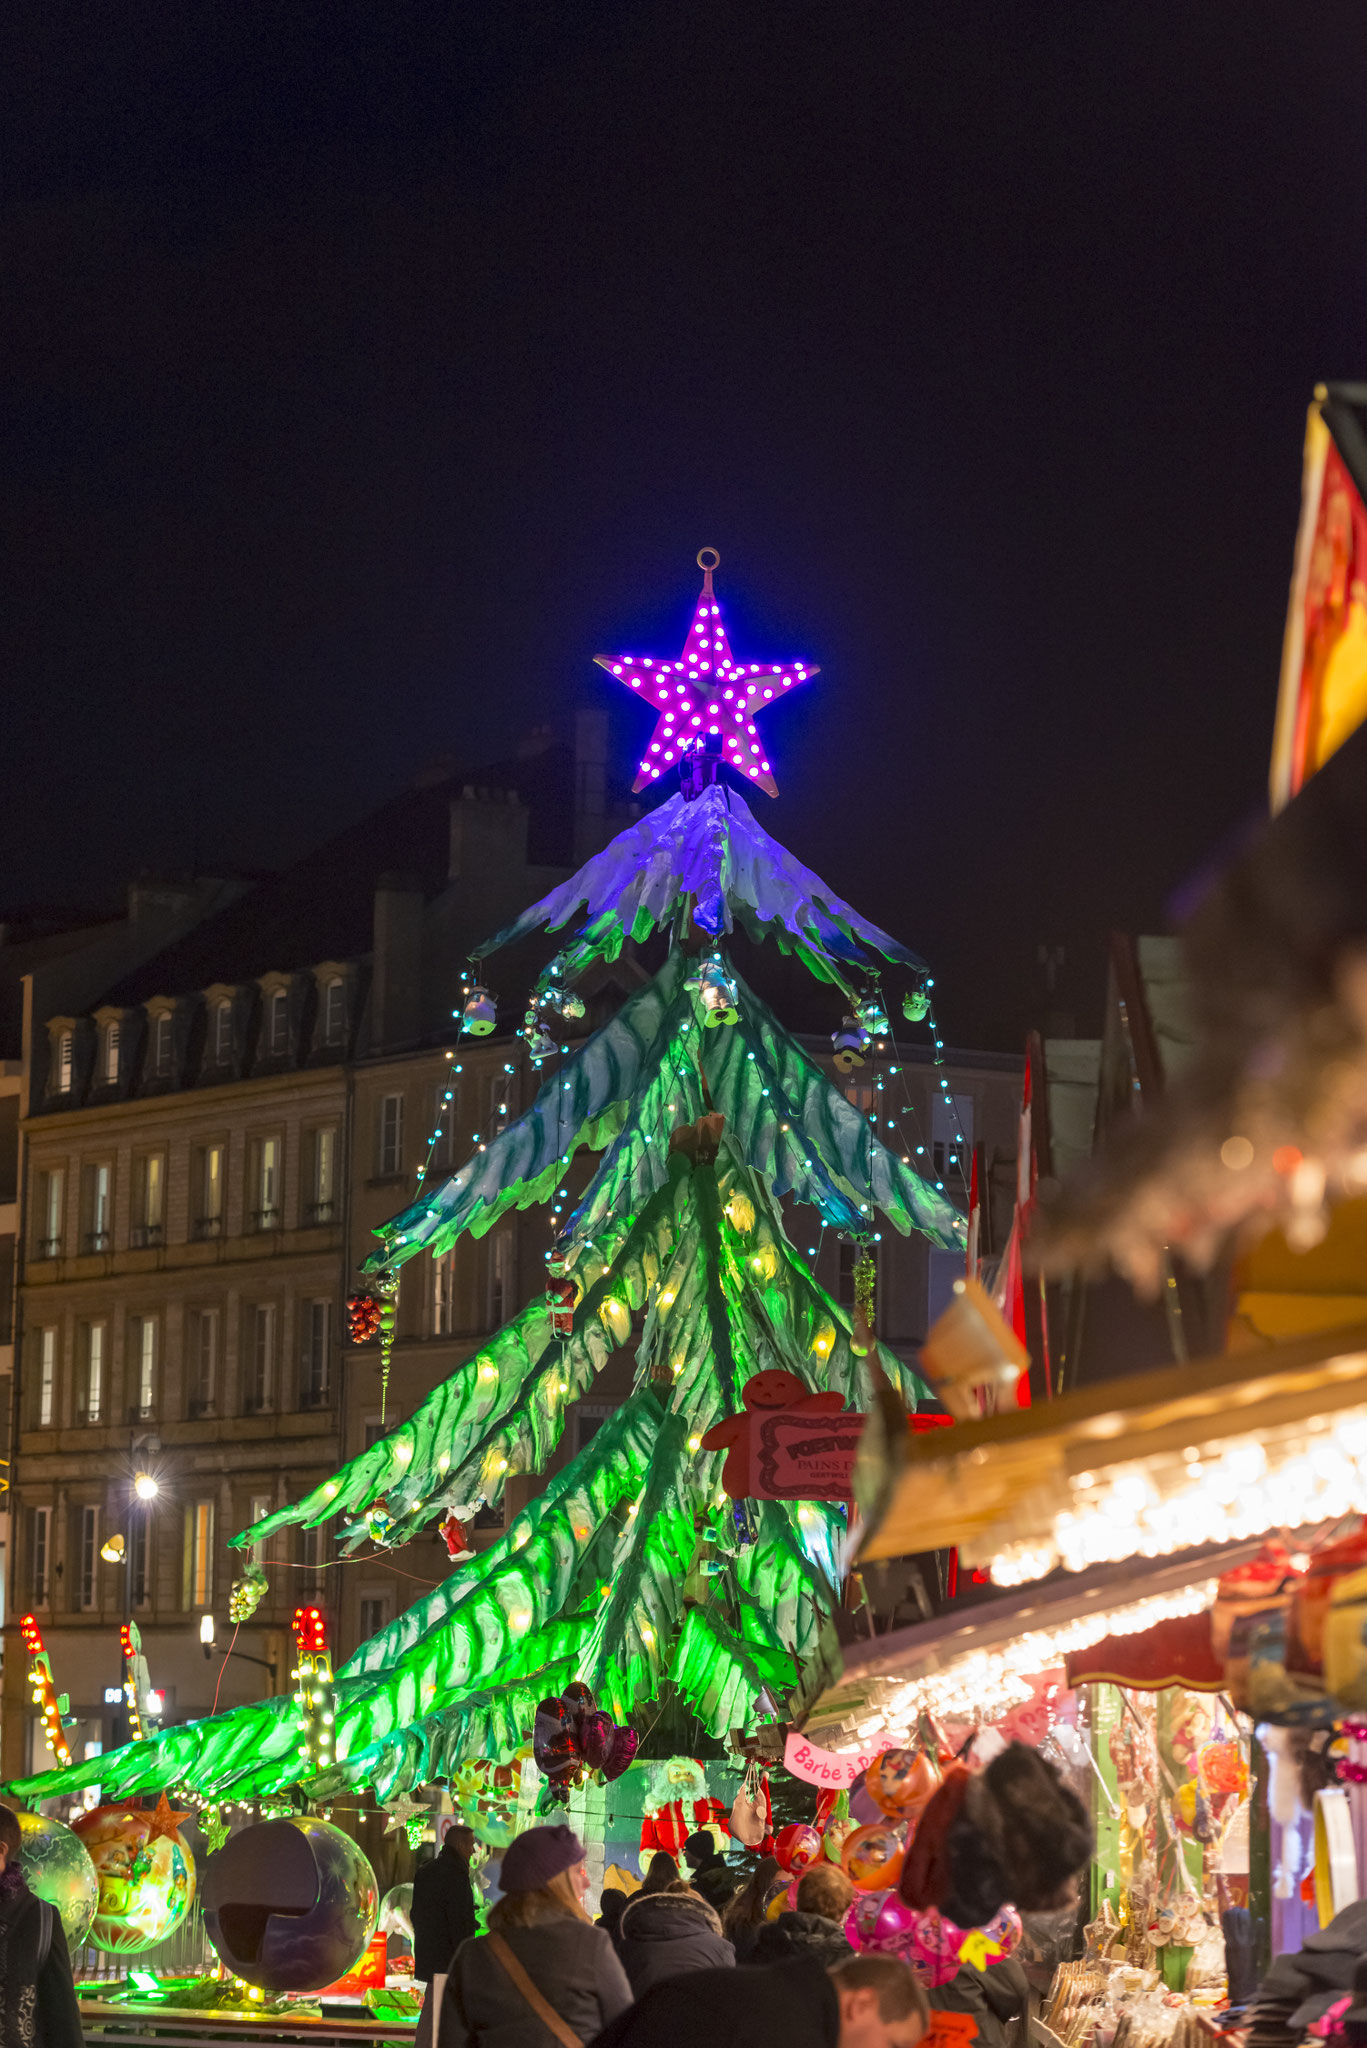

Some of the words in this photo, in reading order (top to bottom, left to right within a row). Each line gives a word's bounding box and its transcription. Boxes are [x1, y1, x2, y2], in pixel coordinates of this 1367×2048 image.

[797, 1460, 841, 1471] PAINS
[793, 1745, 842, 1780] Barbe
[846, 1762, 857, 1779] à
